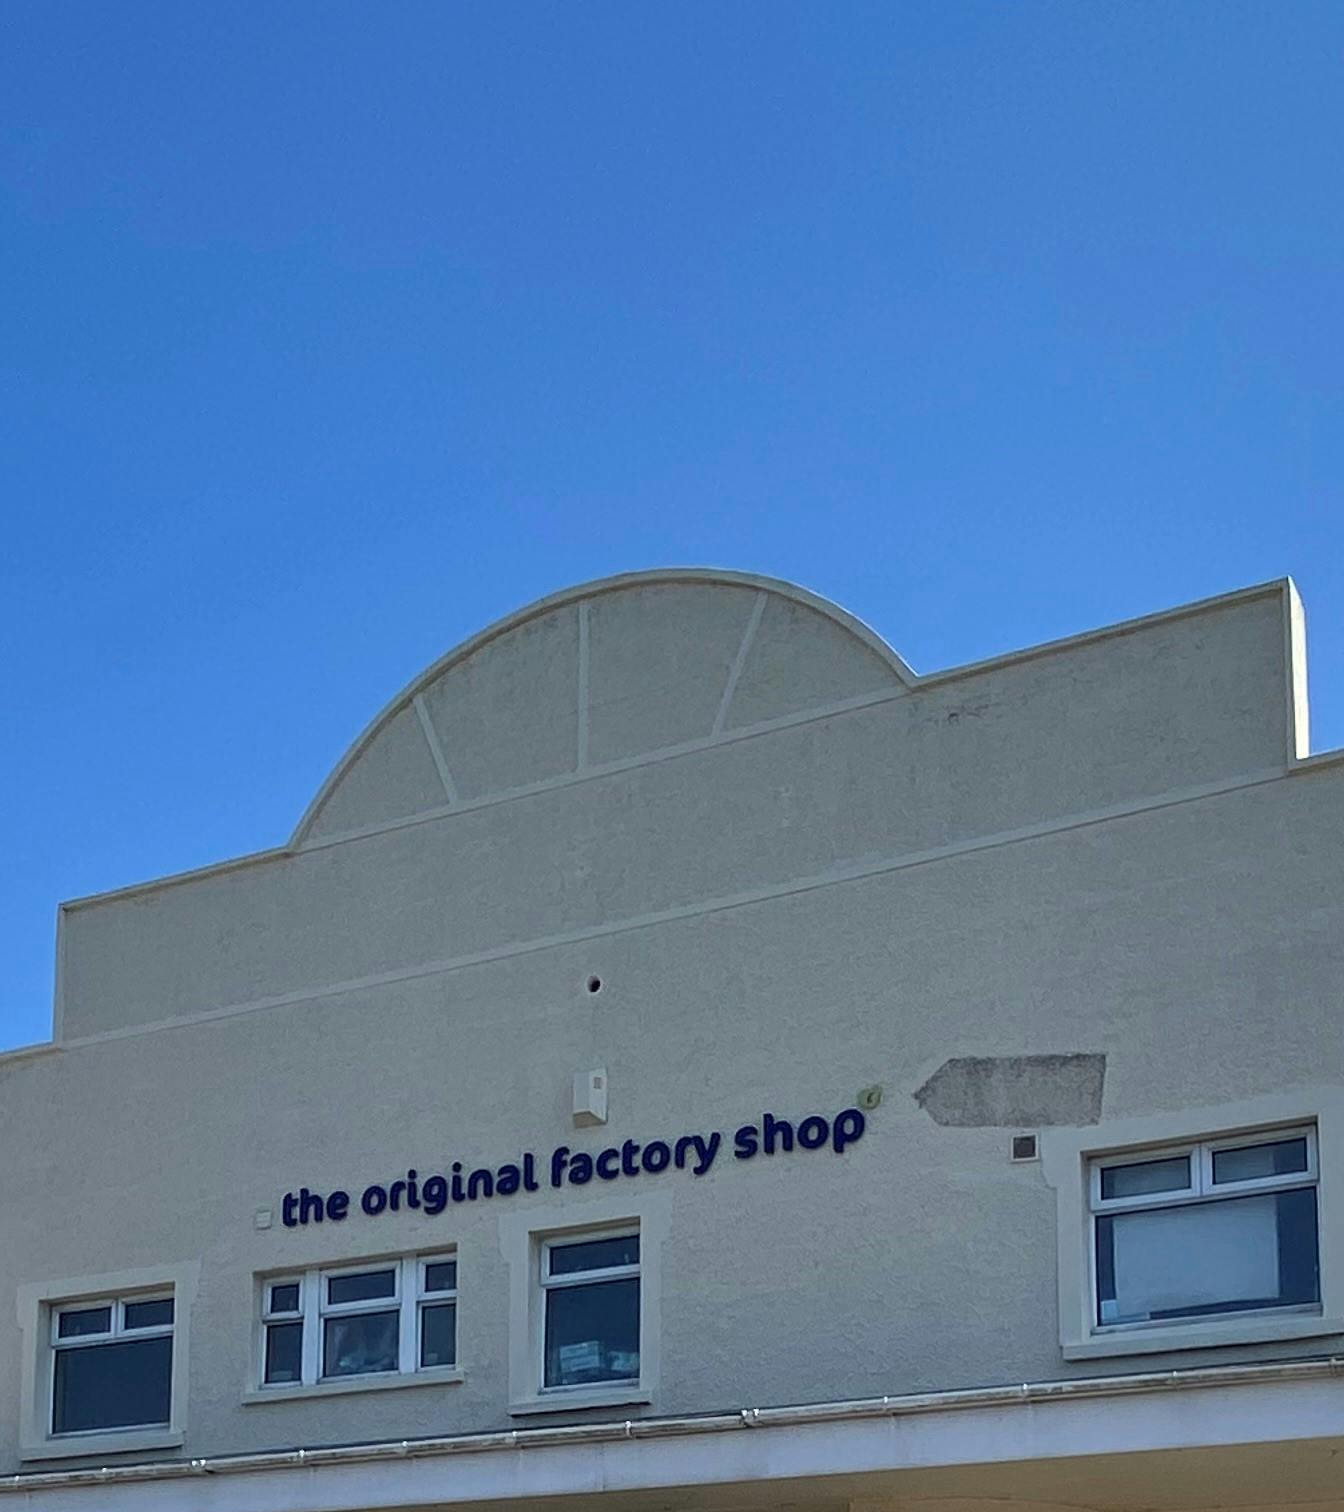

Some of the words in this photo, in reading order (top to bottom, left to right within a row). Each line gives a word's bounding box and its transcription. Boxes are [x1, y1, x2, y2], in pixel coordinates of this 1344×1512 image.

[281, 1188, 349, 1227] the
[361, 1153, 538, 1215] original
[550, 1132, 721, 1187] factory
[734, 1108, 866, 1154] shop
